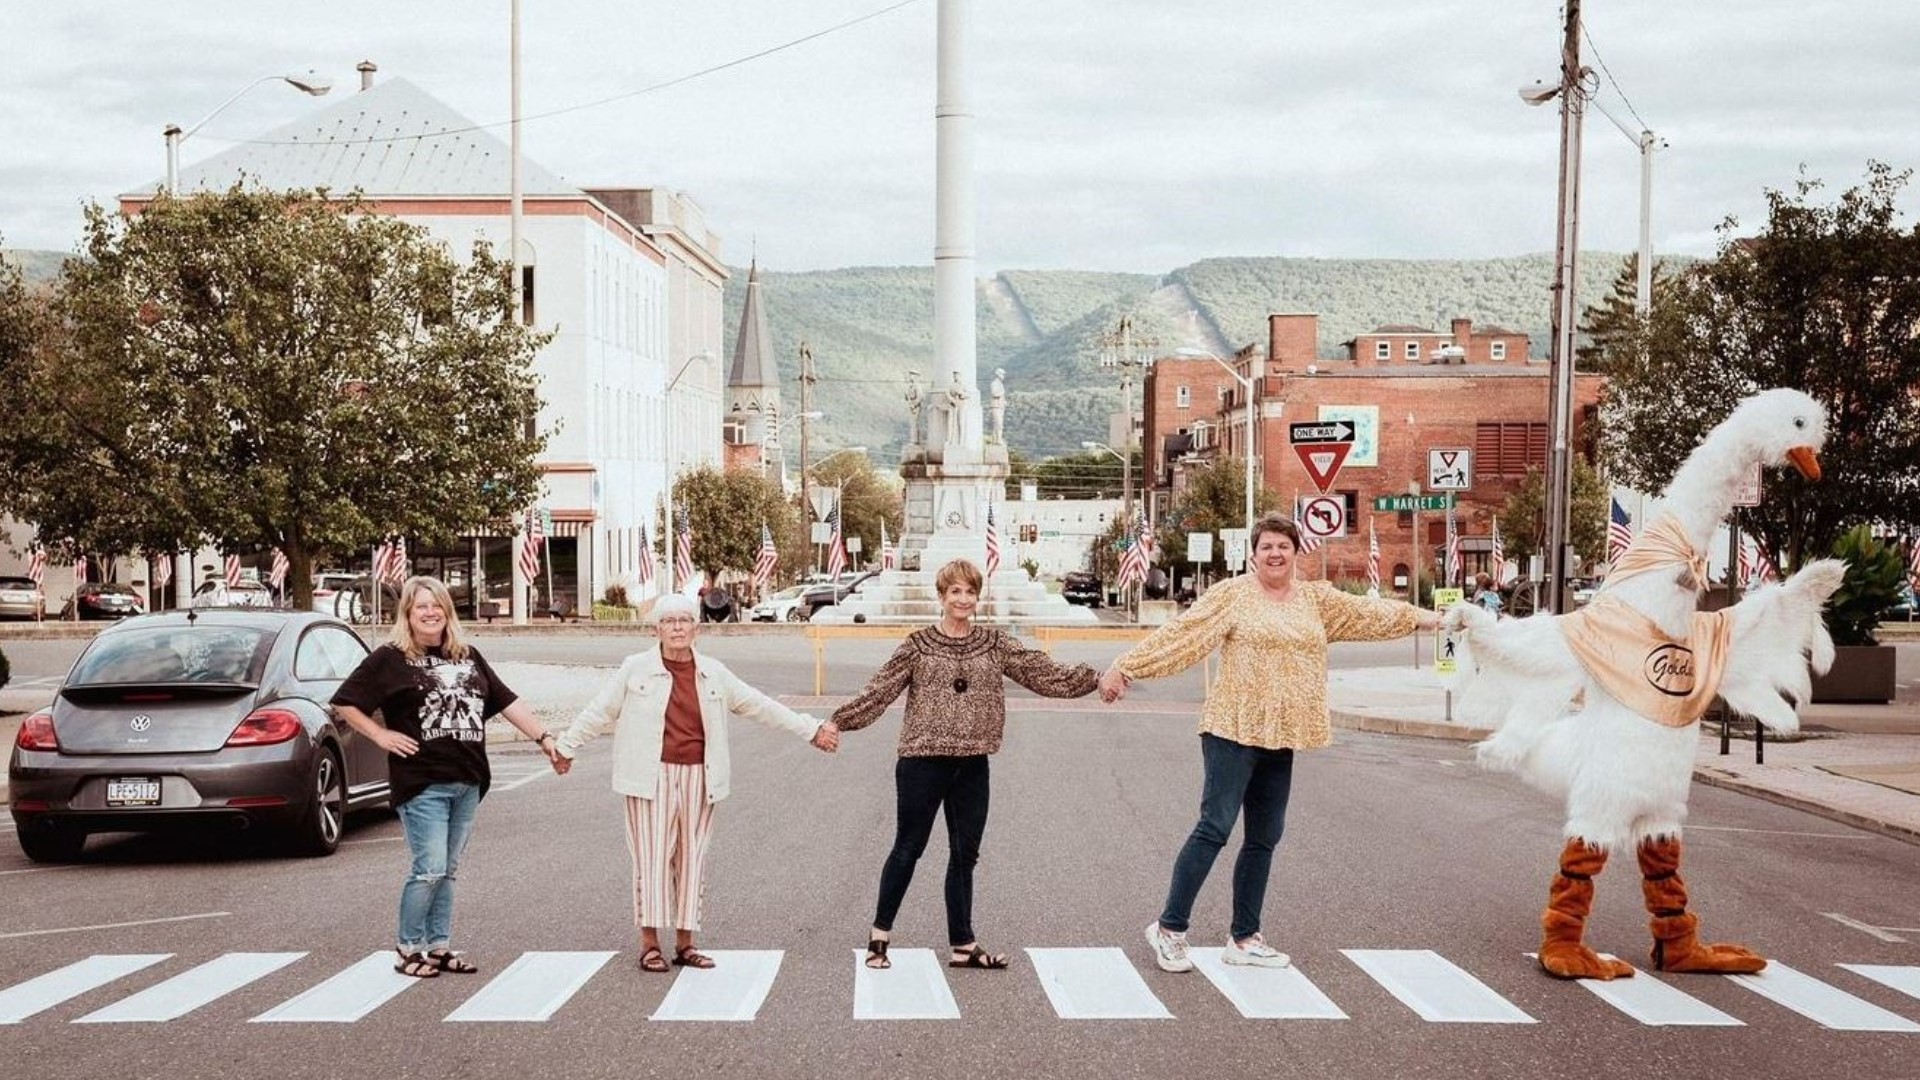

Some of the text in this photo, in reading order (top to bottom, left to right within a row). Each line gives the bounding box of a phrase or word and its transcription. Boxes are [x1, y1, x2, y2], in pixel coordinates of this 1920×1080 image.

[1295, 428, 1336, 438] ONE WAY
[1378, 498, 1387, 510] W
[1393, 497, 1433, 510] MARKET
[460, 730, 484, 741] ROAD
